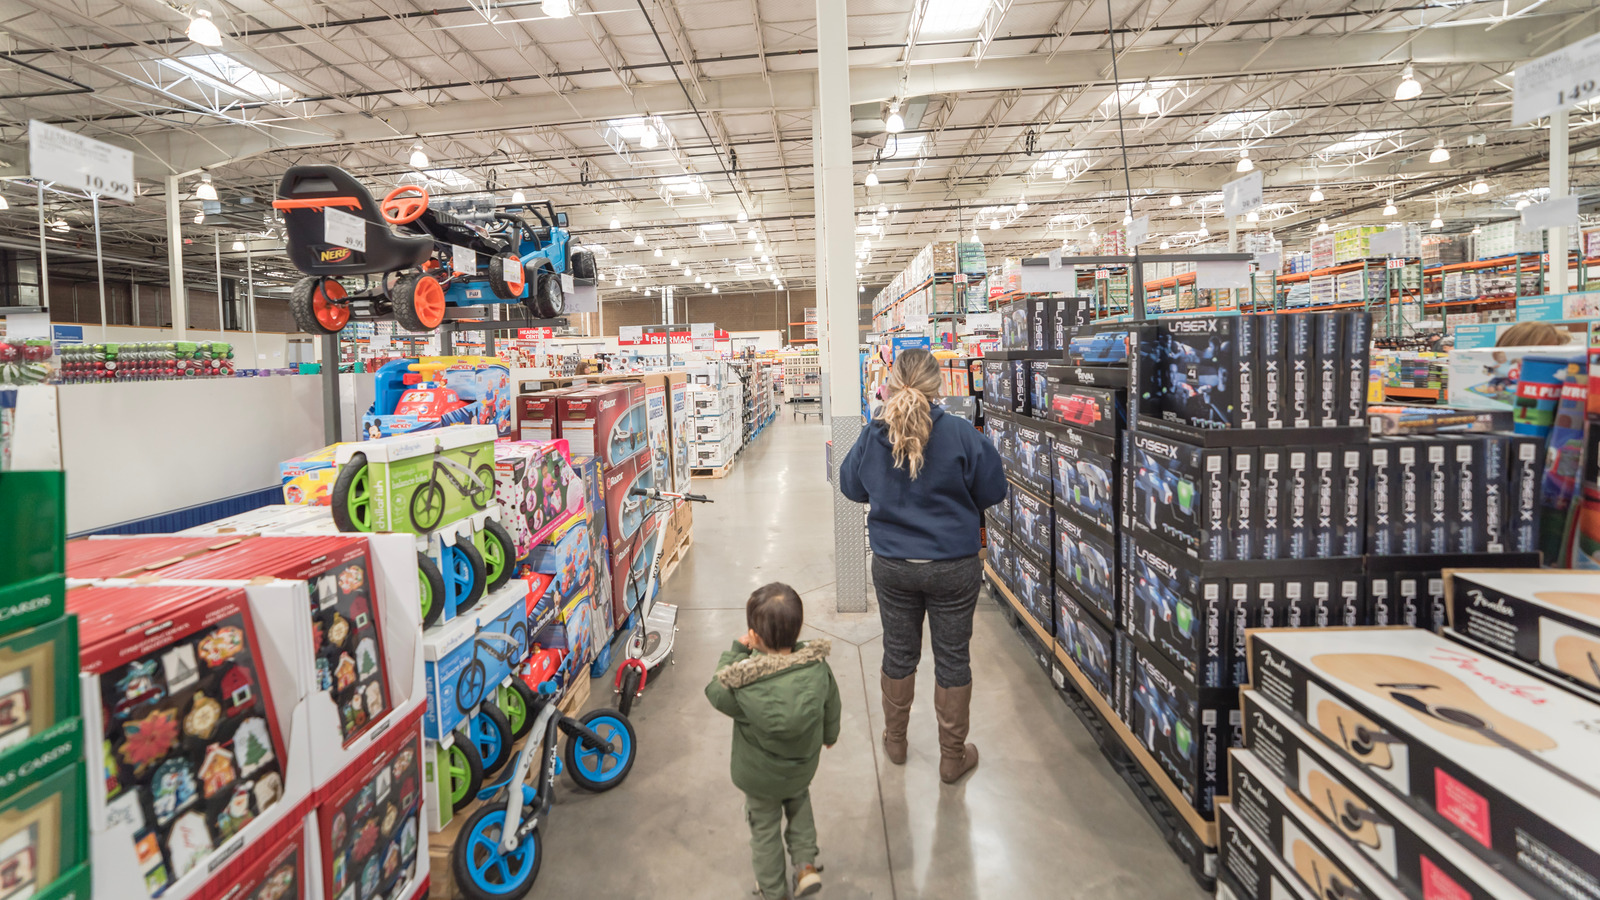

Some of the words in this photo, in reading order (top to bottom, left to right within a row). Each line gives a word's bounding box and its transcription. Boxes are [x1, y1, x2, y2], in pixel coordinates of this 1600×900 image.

[85, 174, 129, 195] 10.99
[321, 248, 349, 261] NERF
[1096, 270, 1107, 279] 312
[651, 335, 692, 344] PHARMAC
[596, 461, 604, 499] NERF
[375, 480, 384, 529] chillafish
[652, 553, 661, 578] Razor
[1467, 589, 1515, 617] Fender
[1260, 650, 1292, 678] Fender
[1253, 712, 1283, 743] Fender
[1238, 772, 1268, 808] Fender
[1227, 826, 1258, 866] Fender
